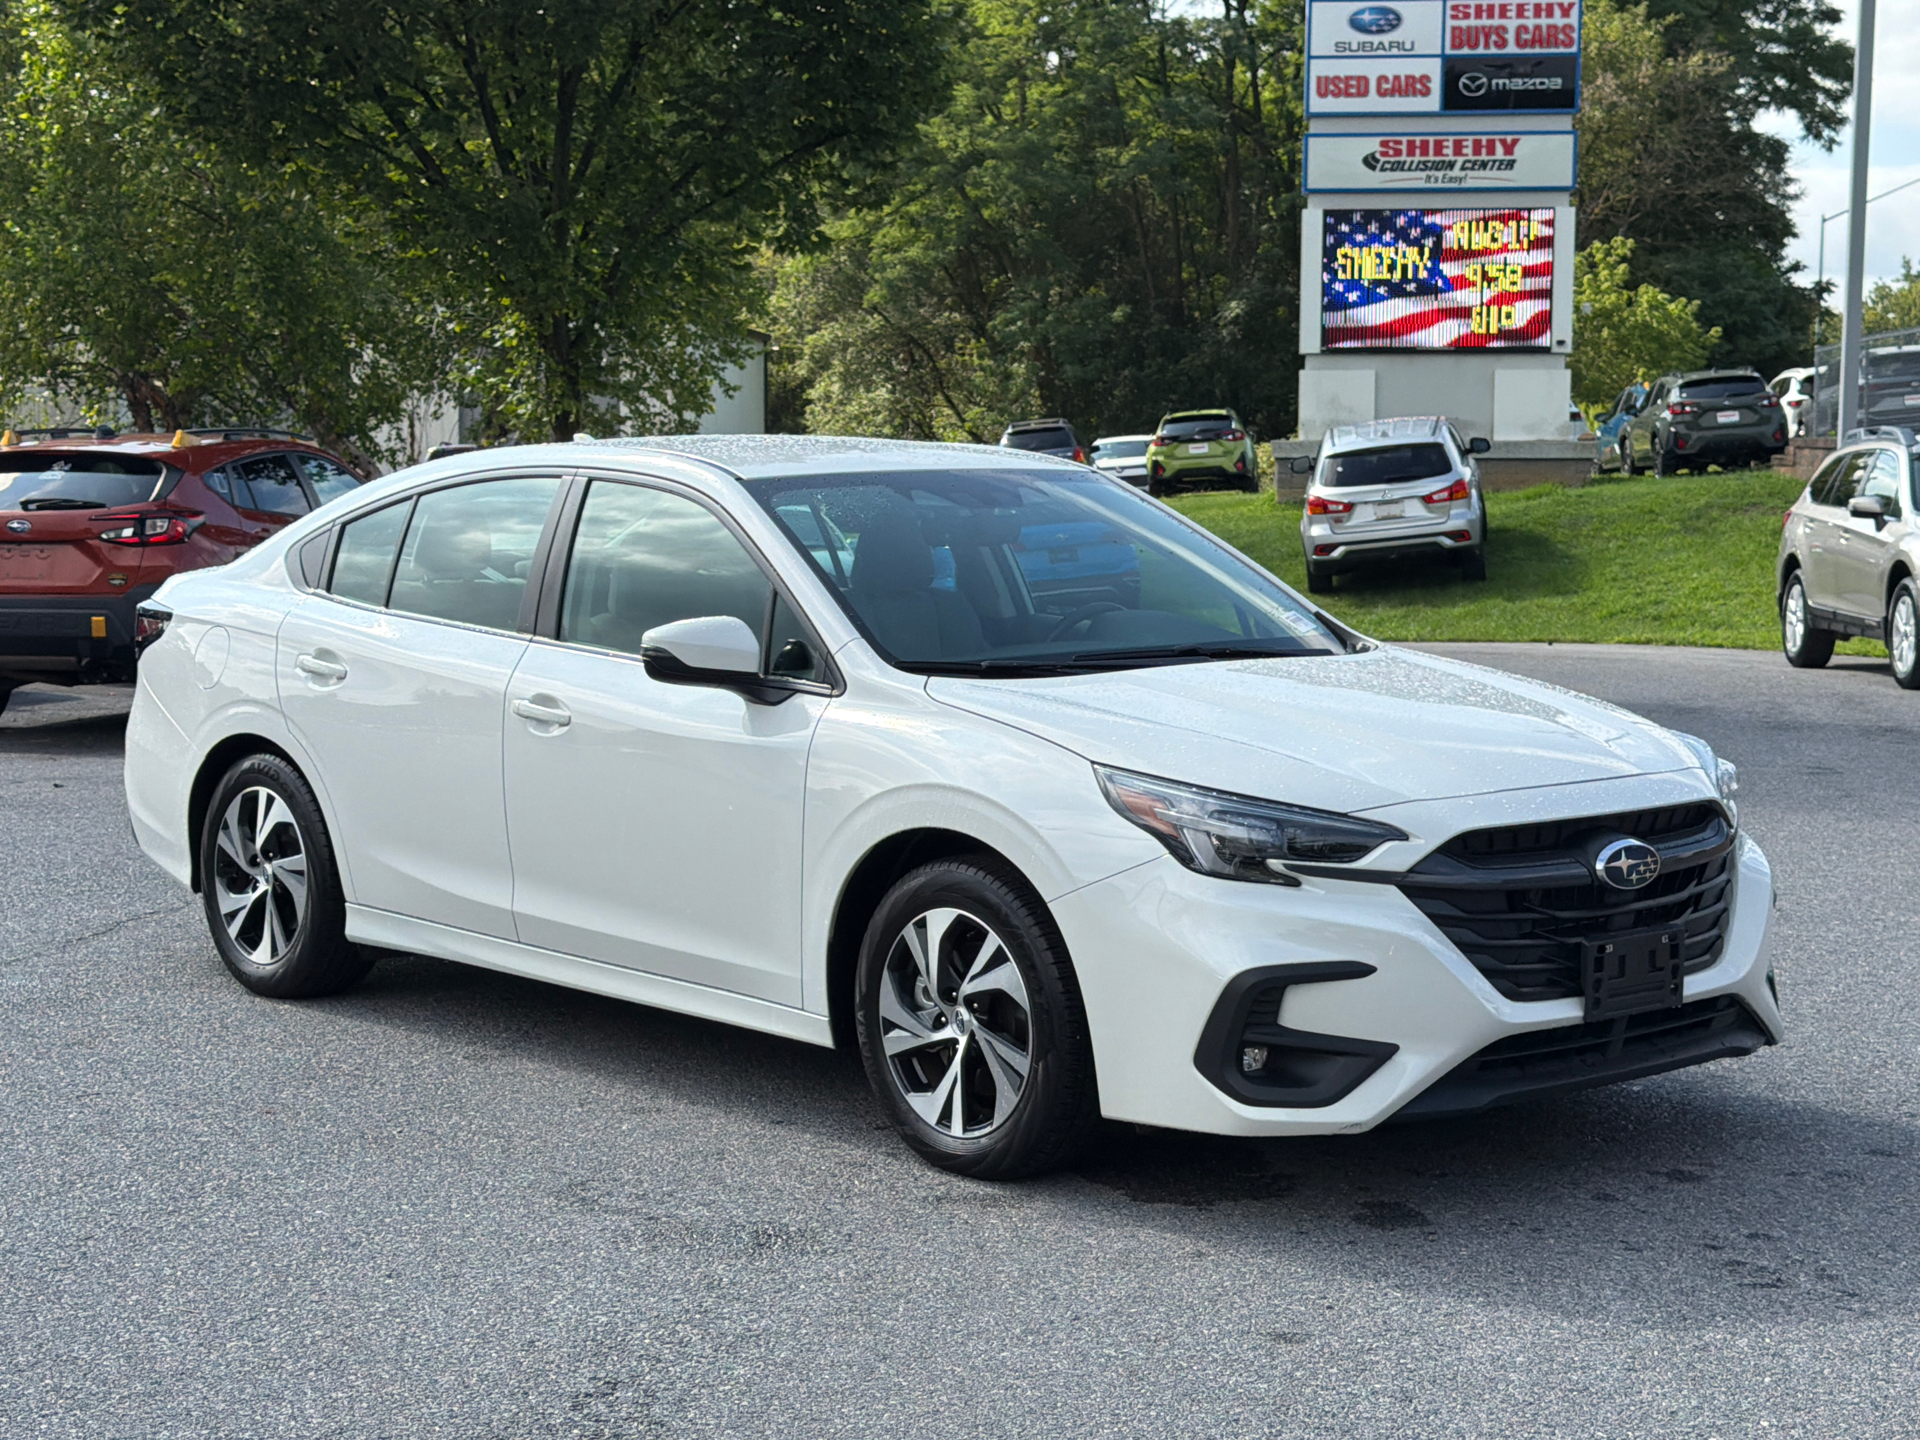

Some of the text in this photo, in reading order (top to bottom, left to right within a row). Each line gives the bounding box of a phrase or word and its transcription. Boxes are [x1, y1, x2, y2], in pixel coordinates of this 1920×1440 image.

[1451, 2, 1575, 21] SHEEHY
[1451, 24, 1575, 50] BUYS CARS
[1334, 40, 1415, 53] SUBARU
[1317, 74, 1431, 98] USED CARS
[1491, 76, 1563, 91] mazda
[1379, 138, 1521, 158] SHEEHY
[1379, 158, 1517, 173] COLLISION CENTER
[1424, 173, 1468, 185] It's Easy!
